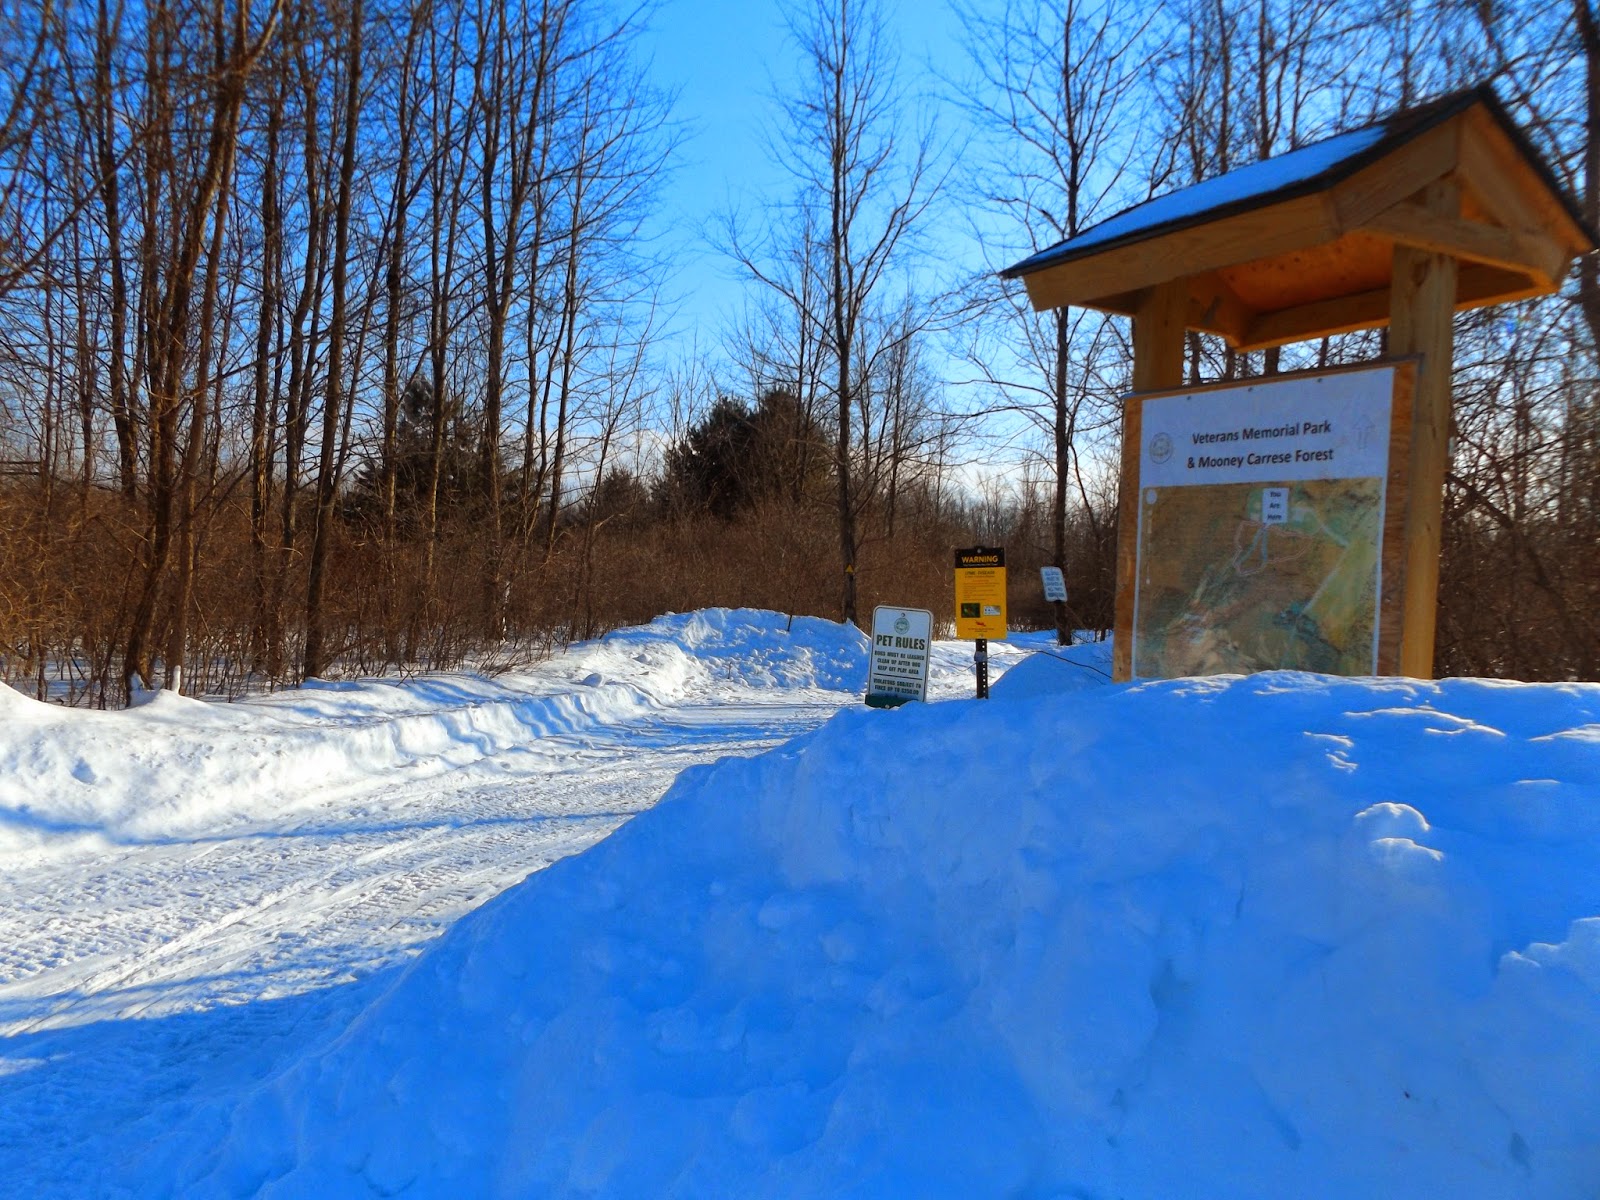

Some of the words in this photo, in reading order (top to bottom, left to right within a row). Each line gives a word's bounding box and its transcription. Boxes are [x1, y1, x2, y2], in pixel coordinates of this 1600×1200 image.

[1192, 432, 1239, 445] Veterans
[1242, 422, 1299, 440] Memorial
[1303, 419, 1331, 435] Park
[1186, 457, 1195, 469] &
[1198, 455, 1244, 468] Mooney
[1247, 453, 1292, 465] Carrese
[1295, 448, 1334, 462] Forest
[961, 555, 999, 563] WARNING
[876, 634, 894, 647] PET
[895, 636, 925, 651] RULES
